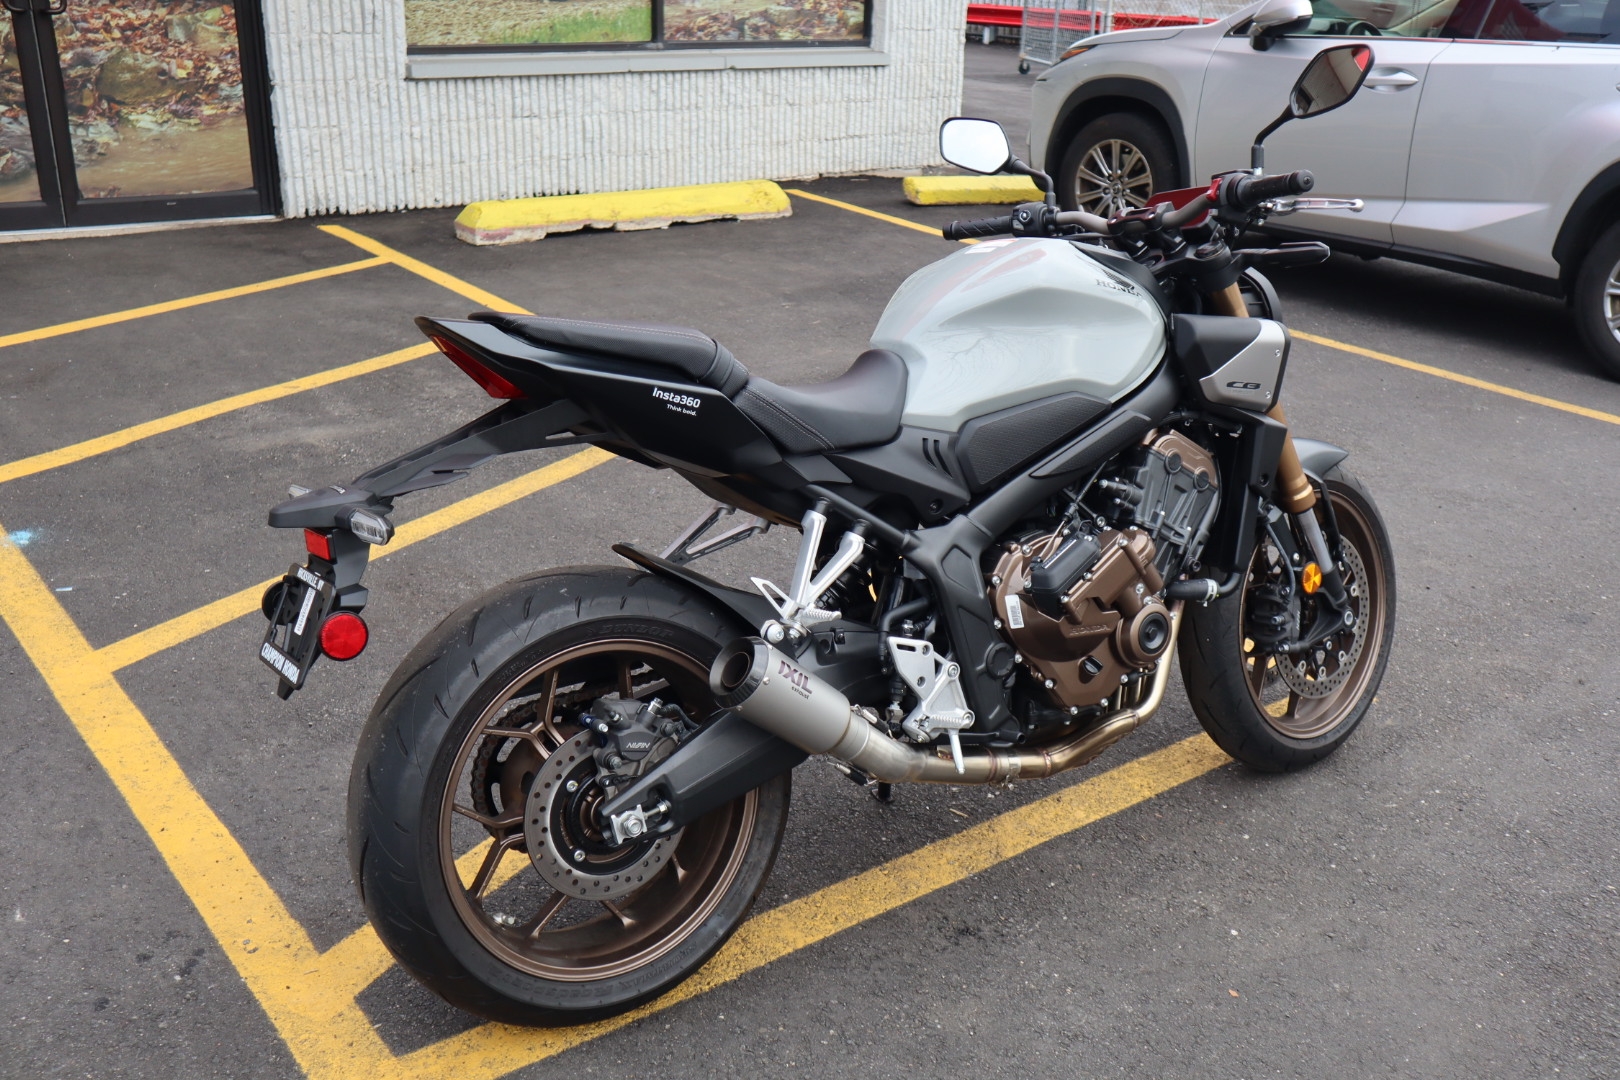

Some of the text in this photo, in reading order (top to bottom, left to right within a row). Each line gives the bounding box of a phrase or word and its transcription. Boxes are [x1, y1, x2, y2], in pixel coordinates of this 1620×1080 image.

[652, 387, 701, 408] Insta360
[667, 404, 682, 413] Think
[778, 660, 812, 695] IXIL
